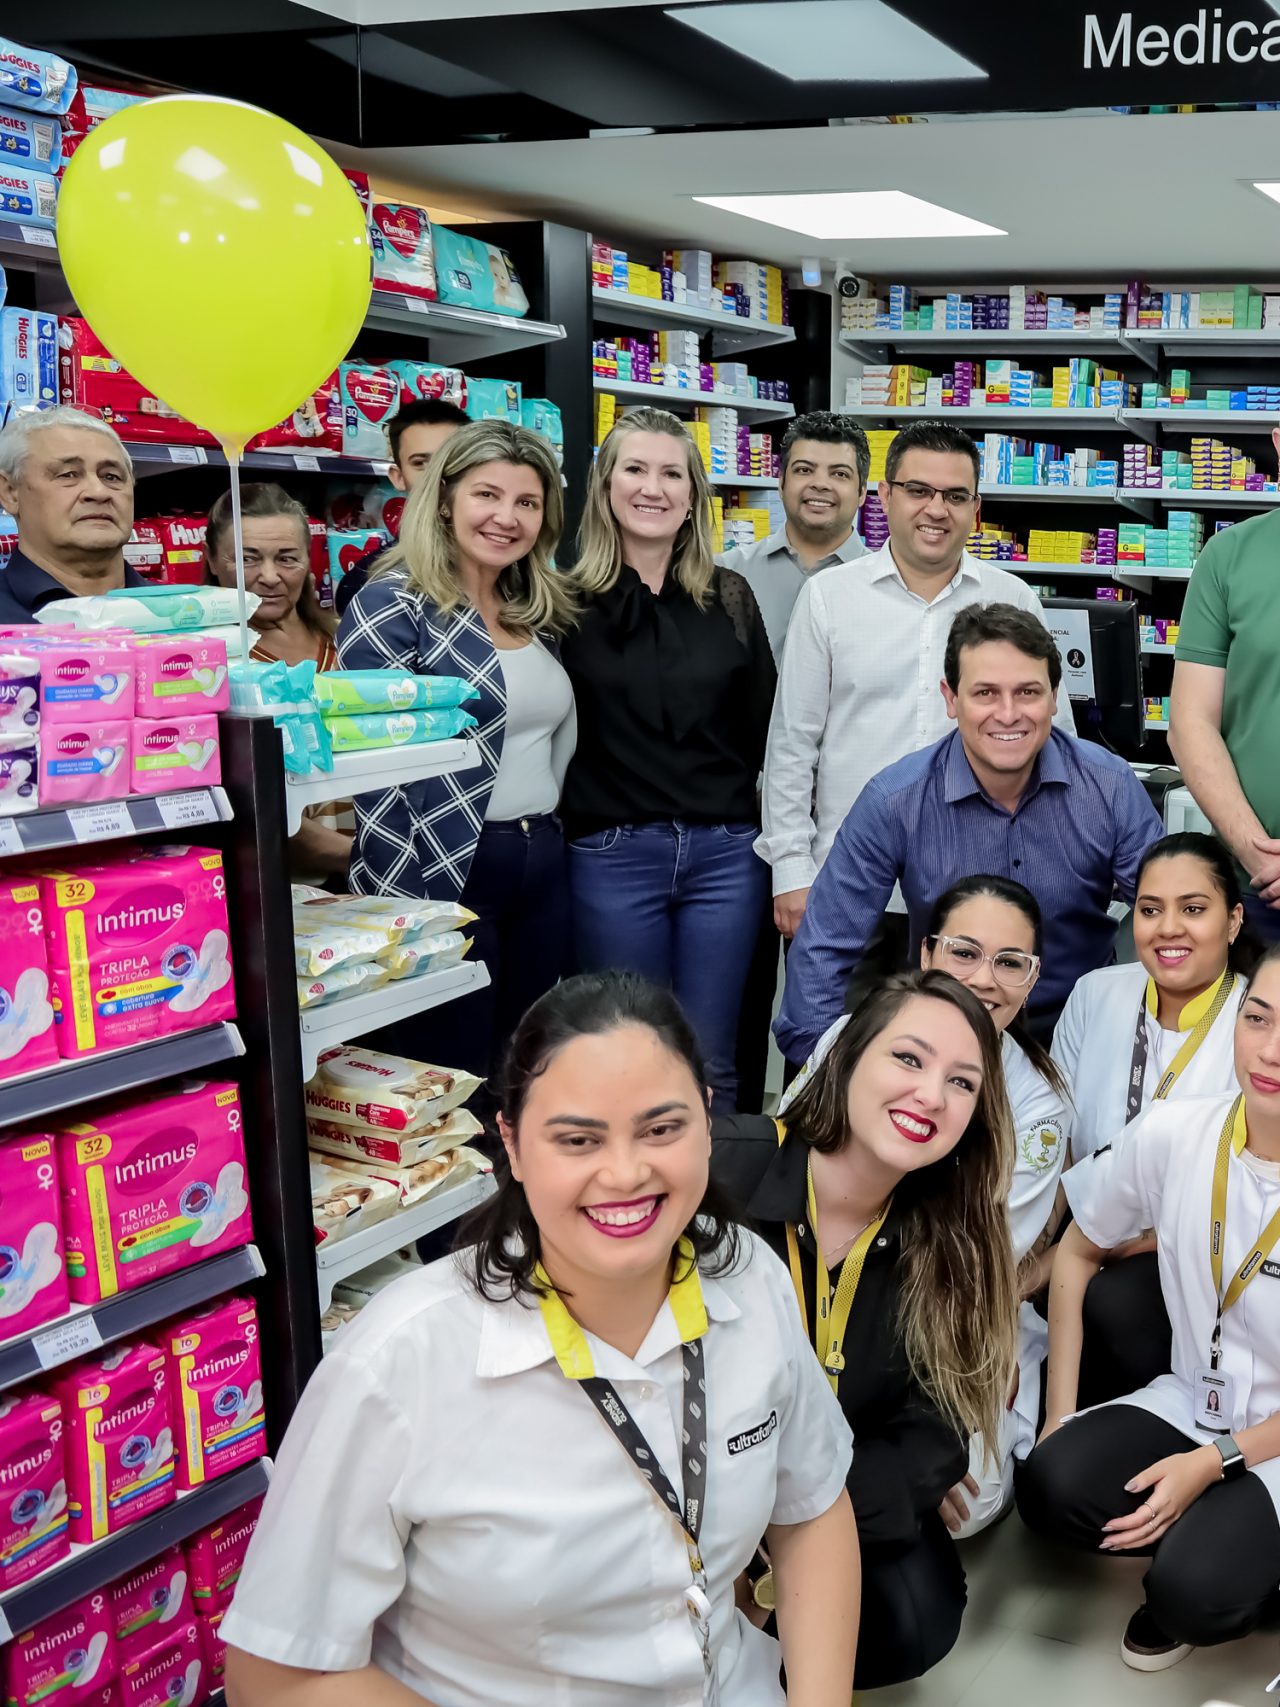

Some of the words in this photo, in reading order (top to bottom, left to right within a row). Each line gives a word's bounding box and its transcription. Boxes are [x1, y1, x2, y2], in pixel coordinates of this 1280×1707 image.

[18, 317, 29, 359] HUGGIES
[988, 385, 995, 393] G
[55, 665, 90, 676] Intimus
[161, 659, 193, 672] Intimus
[57, 738, 90, 749] Intimus
[144, 732, 180, 746] Intimus
[65, 883, 86, 898] 32
[97, 903, 185, 934] Intimus
[100, 955, 150, 976] TRIPLA
[100, 968, 150, 987] PROTEÇÃO
[346, 1061, 396, 1077] HUGGIES
[217, 1092, 236, 1104] NOVO
[305, 1090, 351, 1114] HUGGIES
[25, 1145, 48, 1158] NOVO
[84, 1138, 103, 1154] 32
[115, 1142, 197, 1184] Intimus
[120, 1198, 167, 1224] TRIPLA
[121, 1211, 169, 1235] PROTEÇÃO
[180, 1338, 192, 1348] 16
[187, 1348, 249, 1383] Intimus
[87, 1389, 101, 1400] 16
[94, 1395, 155, 1437] Intimus
[215, 1519, 258, 1555] Intimus
[113, 1563, 165, 1600] Intimus
[24, 1622, 85, 1662] Intimus
[131, 1651, 182, 1691] Intimus
